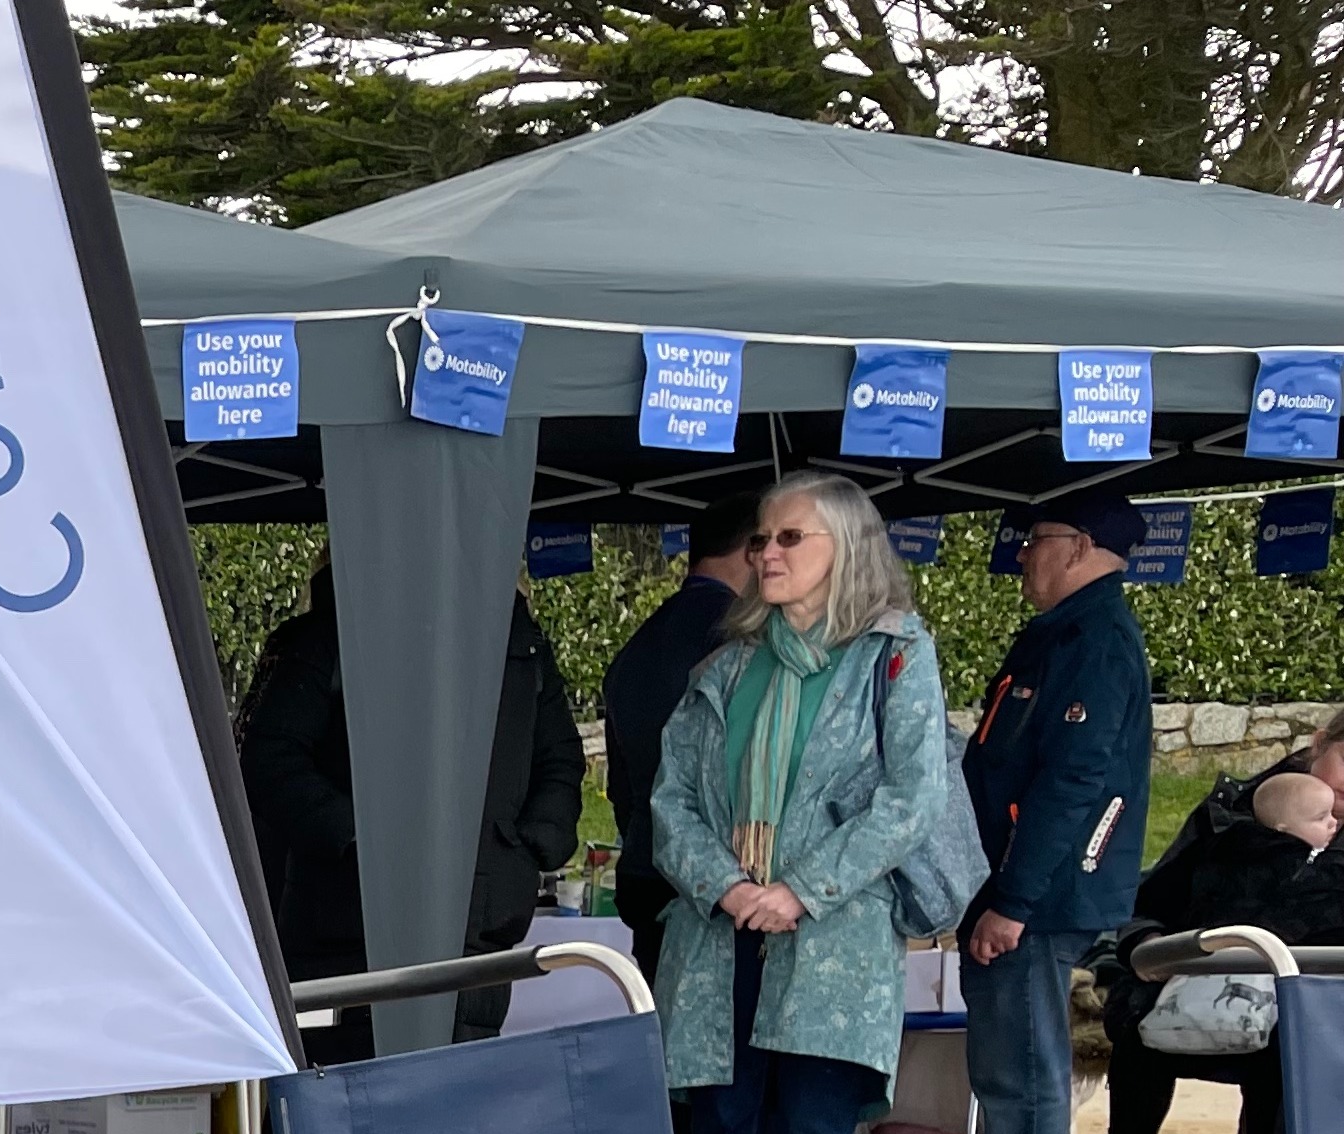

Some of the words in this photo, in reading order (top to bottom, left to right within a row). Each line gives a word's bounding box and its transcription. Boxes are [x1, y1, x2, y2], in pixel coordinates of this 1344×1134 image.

[196, 332, 234, 352] Use
[238, 334, 283, 355] your
[198, 352, 284, 378] mobility
[656, 343, 690, 363] Use
[692, 348, 732, 369] your
[445, 354, 507, 386] Motability
[658, 367, 729, 395] mobility
[1071, 361, 1103, 379] Use
[1105, 364, 1142, 384] your
[190, 380, 292, 402] allowance
[647, 388, 733, 415] allowance
[875, 389, 940, 412] Motability
[1073, 382, 1141, 406] mobility
[217, 404, 263, 425] here
[1067, 405, 1148, 425] allowance
[1277, 394, 1335, 414] Motability
[667, 412, 707, 437] here
[1087, 428, 1125, 448] here
[543, 533, 590, 547] Motability
[1146, 526, 1183, 542] bility
[1278, 521, 1328, 536] Motability
[1136, 560, 1165, 574] here
